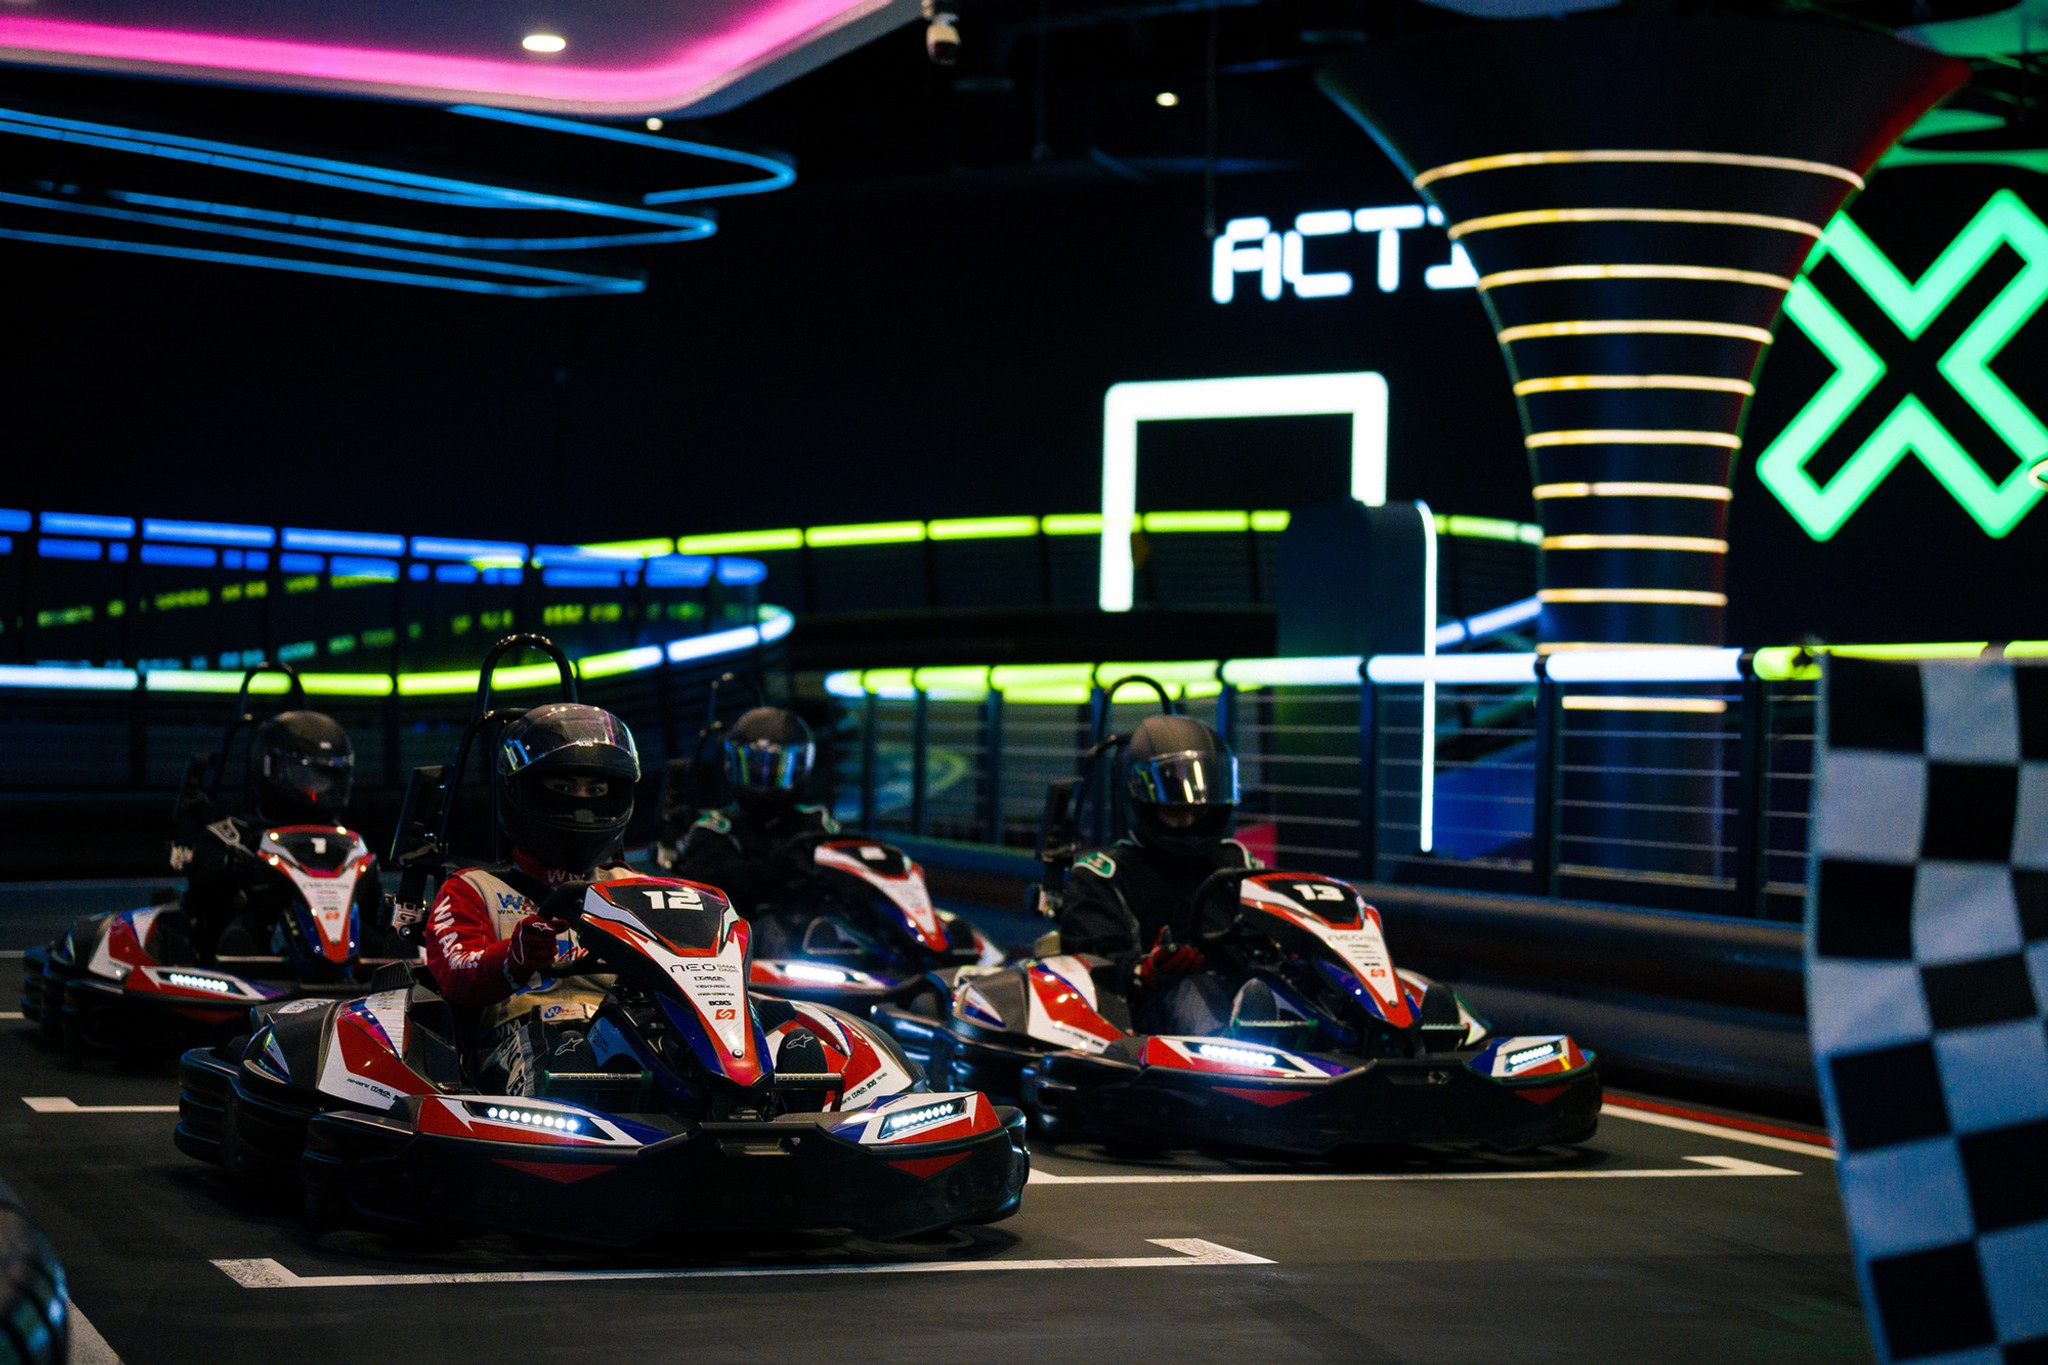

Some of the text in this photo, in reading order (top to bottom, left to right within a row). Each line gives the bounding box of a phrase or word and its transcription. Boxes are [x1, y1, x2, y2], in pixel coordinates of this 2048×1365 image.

[310, 837, 327, 854] 1
[641, 890, 704, 911] 12
[1292, 883, 1345, 902] 13
